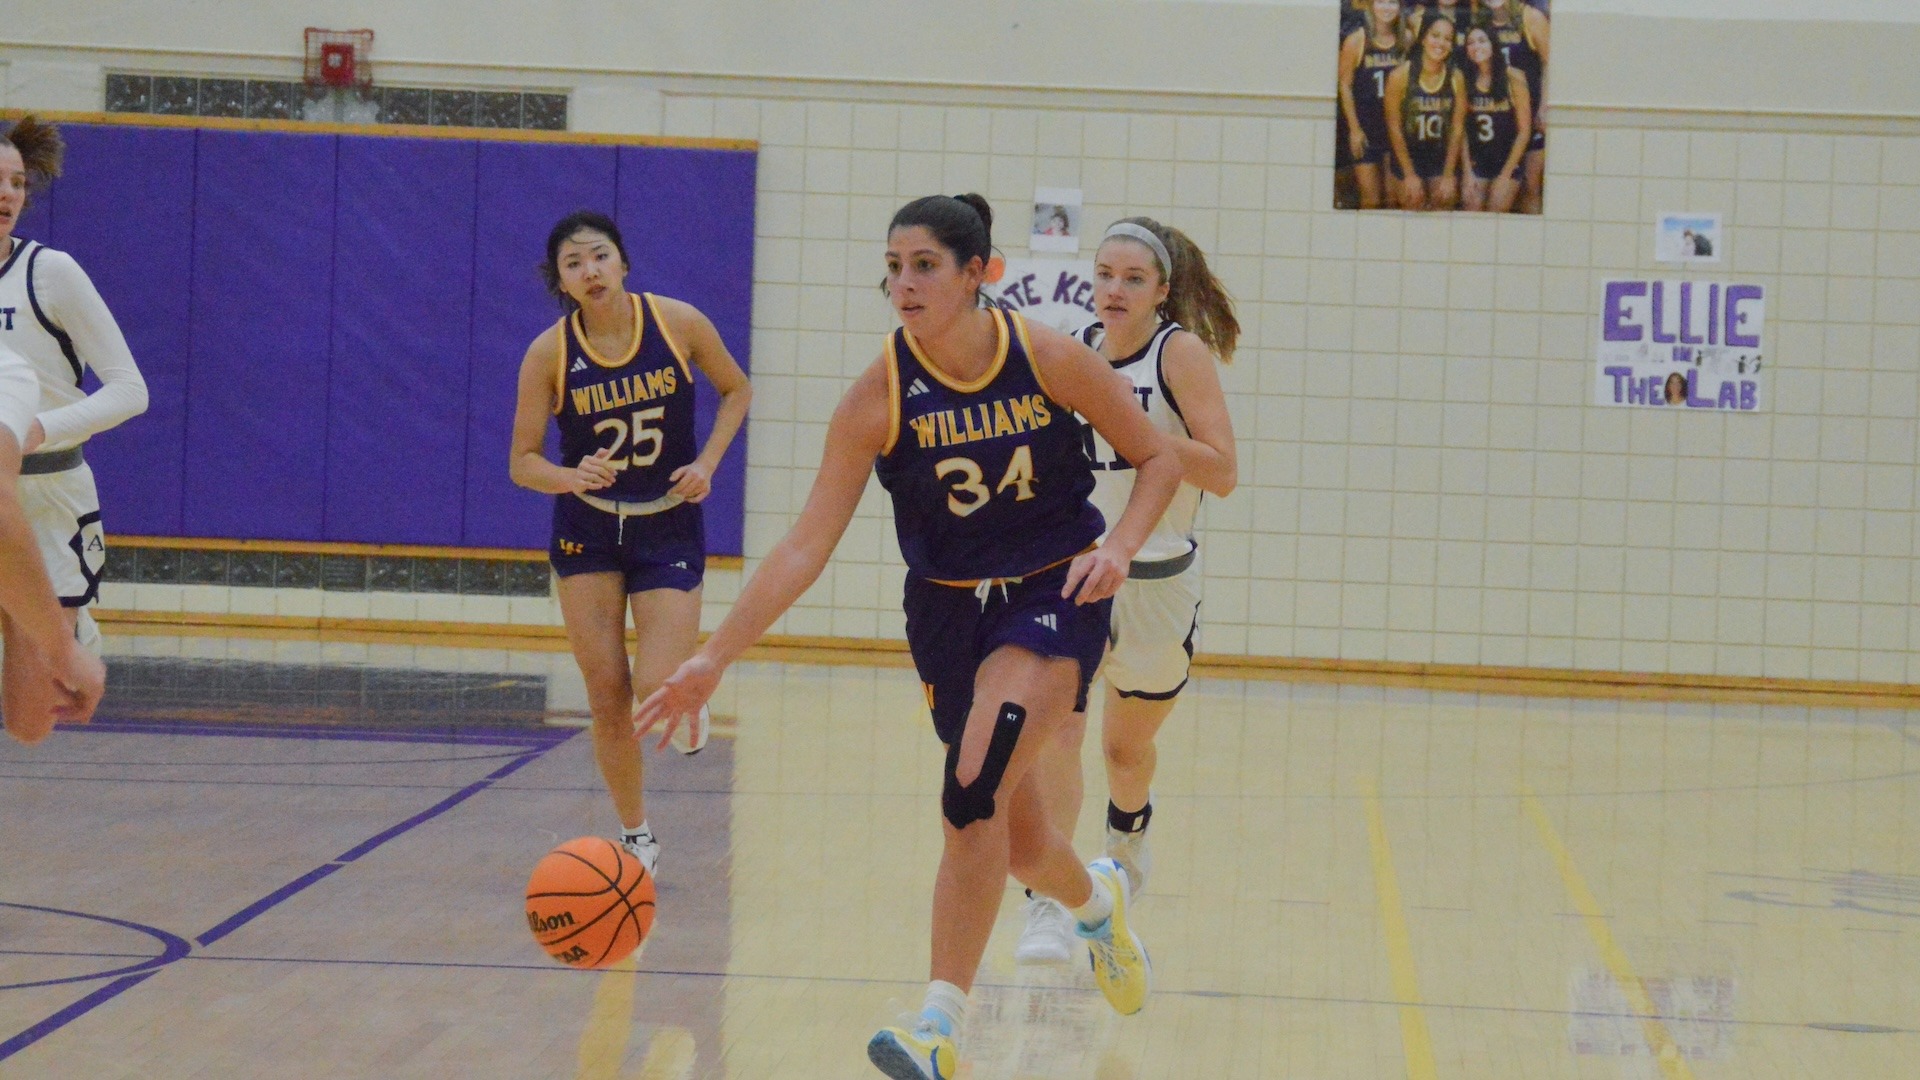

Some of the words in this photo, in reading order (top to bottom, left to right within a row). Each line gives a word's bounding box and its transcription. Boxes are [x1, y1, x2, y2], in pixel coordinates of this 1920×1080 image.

[1416, 114, 1443, 140] 10
[1477, 114, 1494, 141] 3
[0, 307, 16, 331] T
[1603, 280, 1763, 348] ELLIE
[571, 366, 677, 415] WILLIAMS
[1133, 386, 1153, 412] T
[1604, 366, 1665, 406] THE
[1686, 368, 1757, 410] LAB
[593, 406, 665, 471] 25
[909, 394, 1052, 448] WILLIAMS
[935, 445, 1039, 517] 34
[87, 534, 104, 551] A
